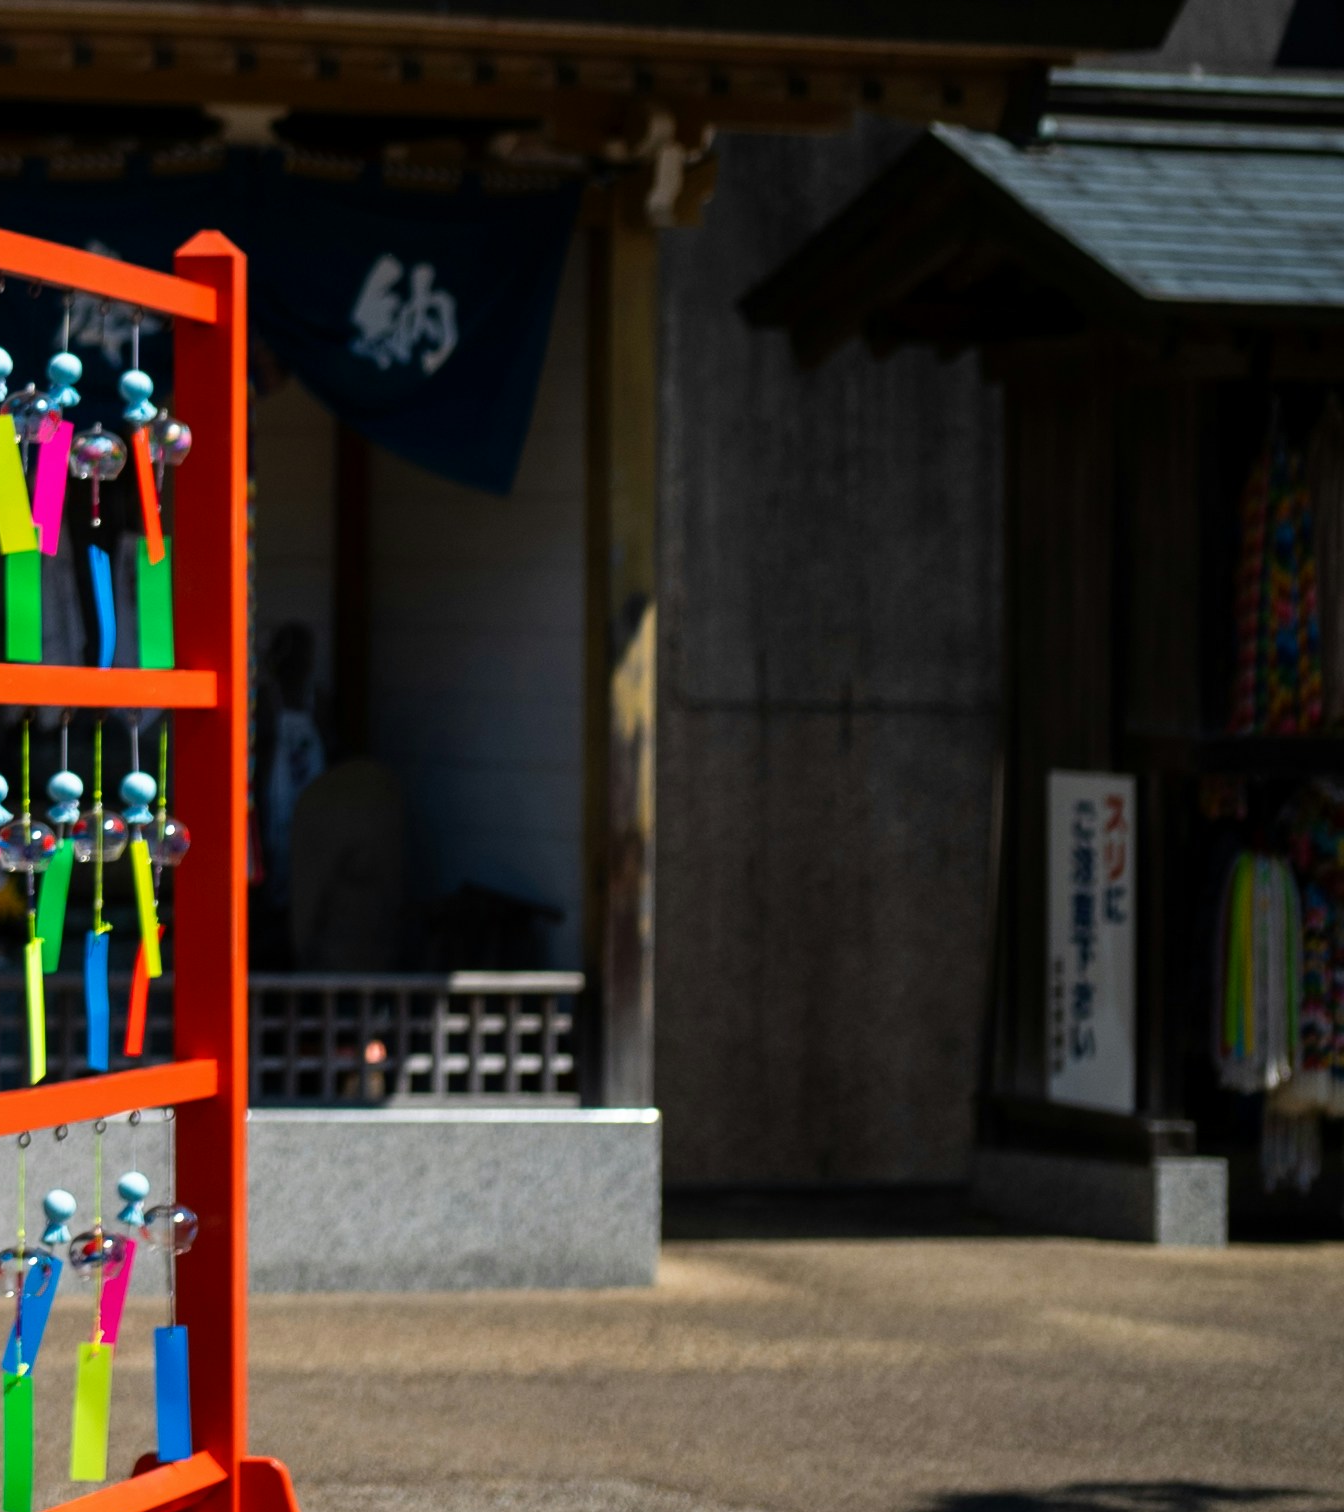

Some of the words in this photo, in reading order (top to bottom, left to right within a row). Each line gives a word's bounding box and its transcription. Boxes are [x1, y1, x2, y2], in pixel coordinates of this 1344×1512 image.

[350, 253, 459, 376] 納
[1103, 792, 1129, 925] スリに
